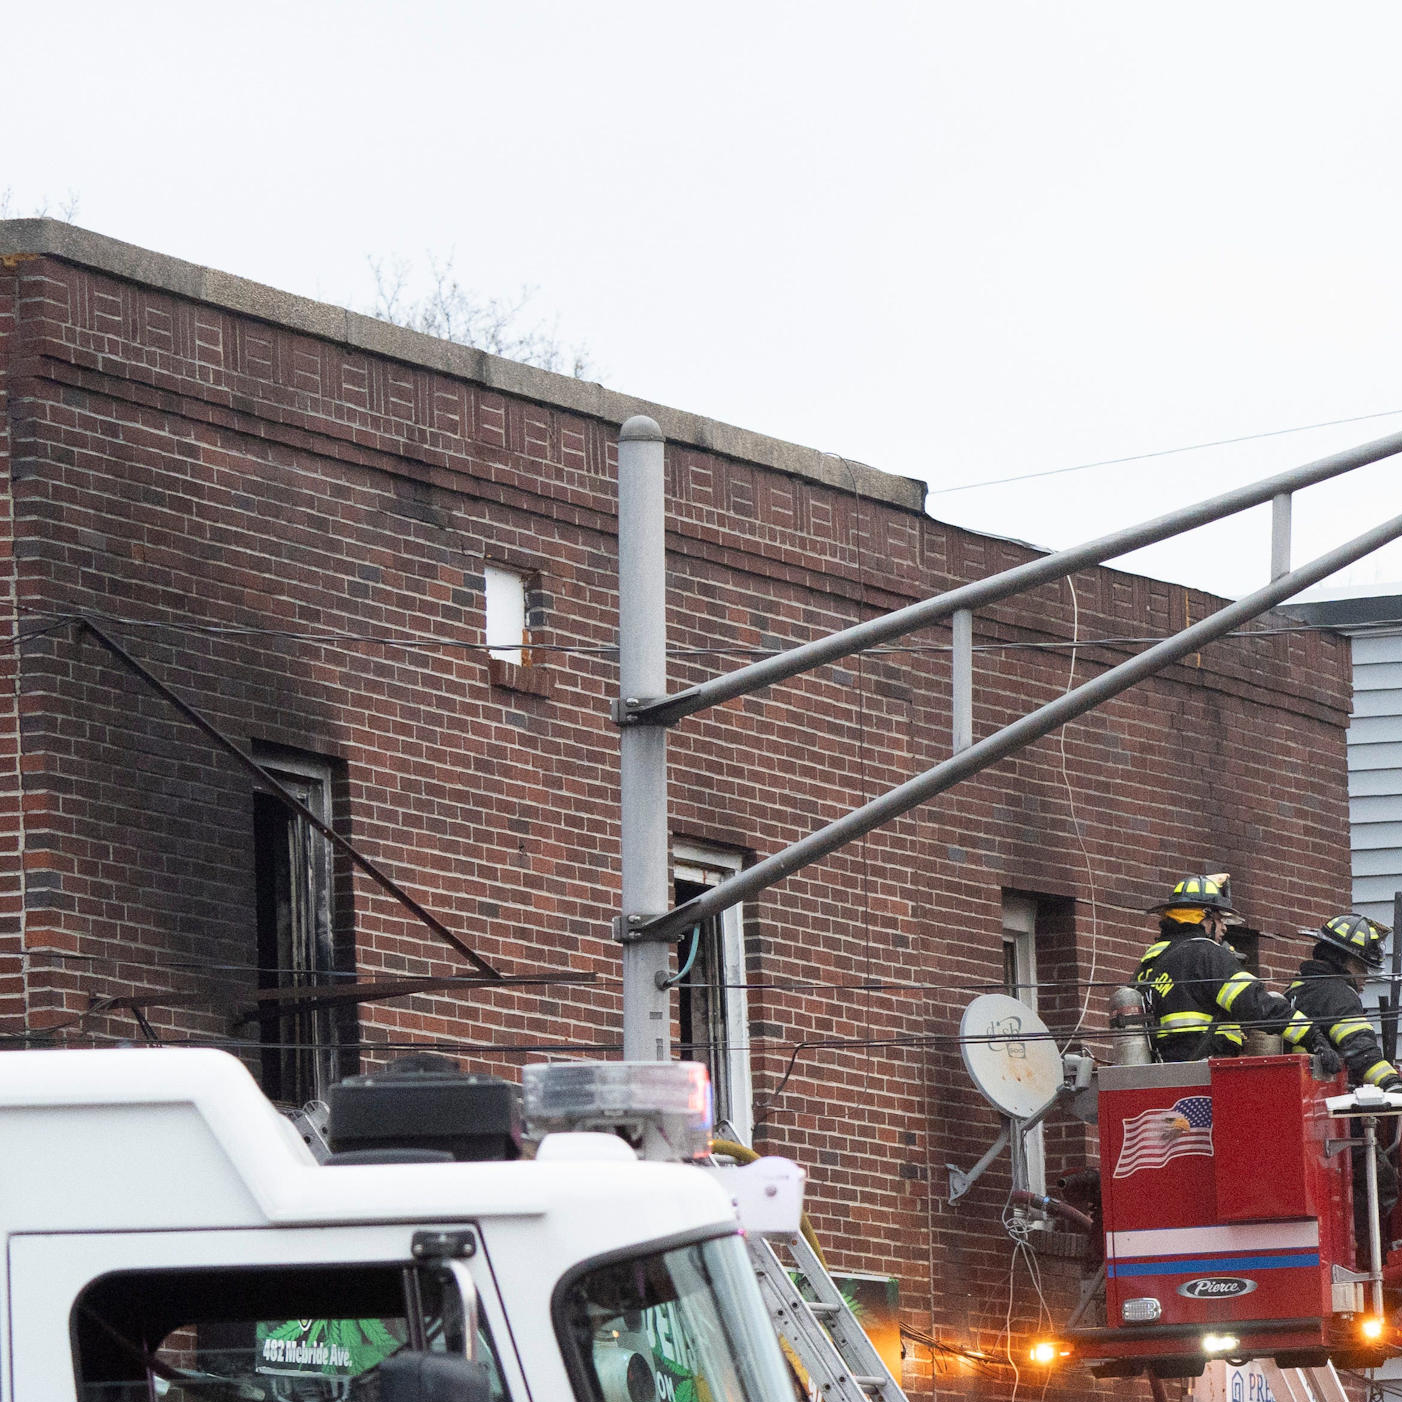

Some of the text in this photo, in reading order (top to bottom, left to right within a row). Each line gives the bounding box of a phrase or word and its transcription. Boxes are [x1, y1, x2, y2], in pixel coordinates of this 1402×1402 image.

[1195, 1278, 1241, 1294] Pierce
[263, 1339, 285, 1362] 482
[329, 1344, 353, 1368] Ave.
